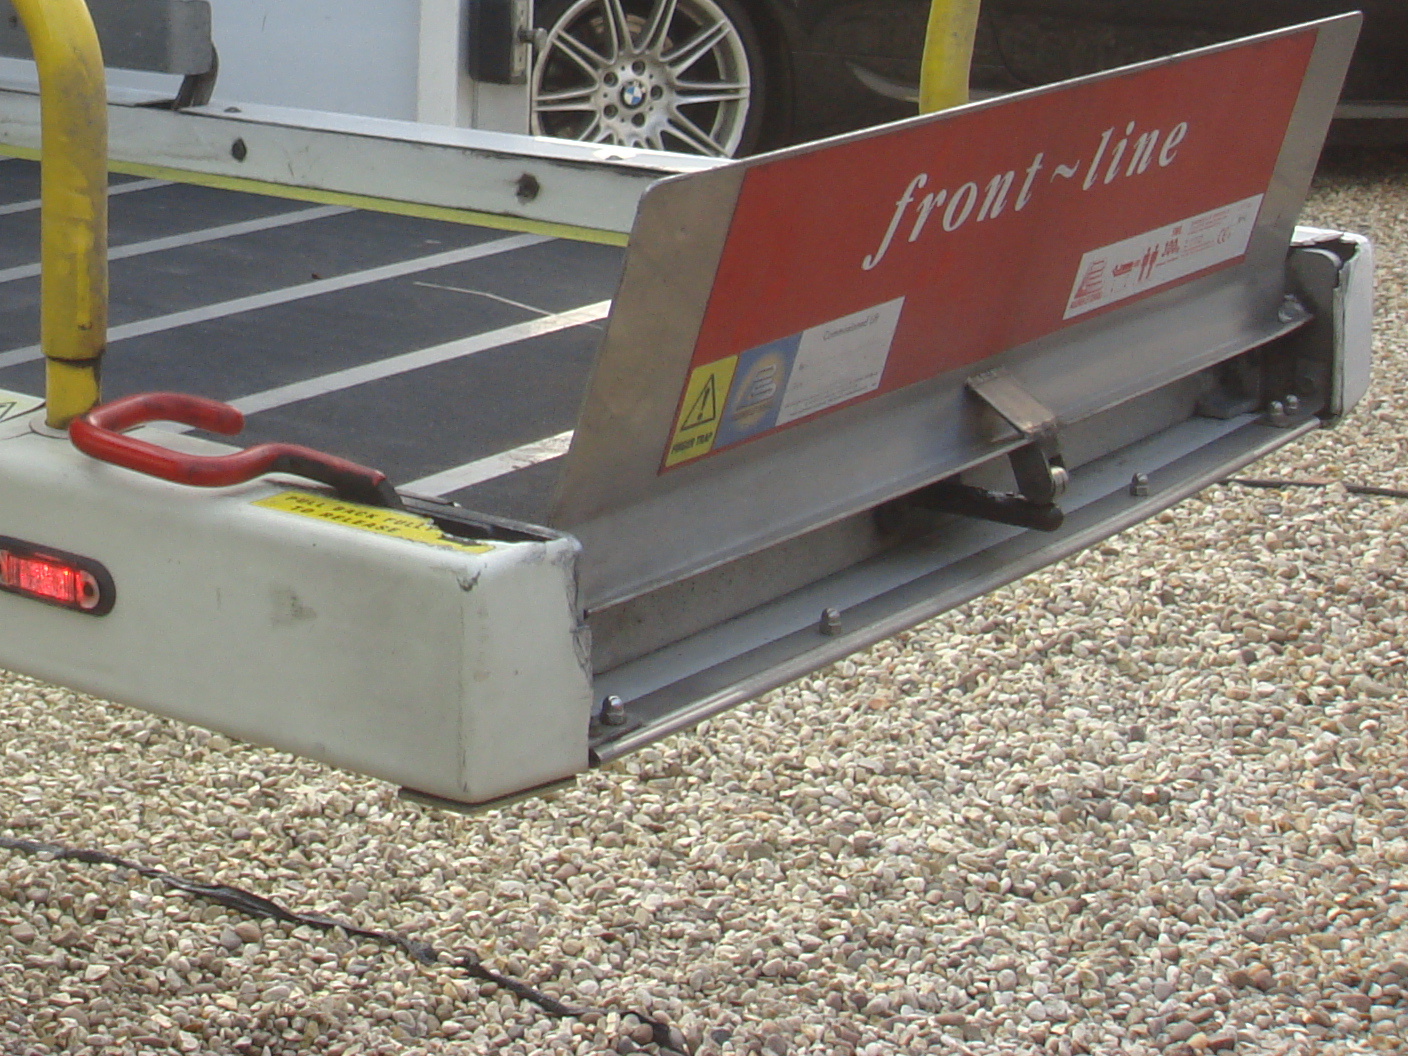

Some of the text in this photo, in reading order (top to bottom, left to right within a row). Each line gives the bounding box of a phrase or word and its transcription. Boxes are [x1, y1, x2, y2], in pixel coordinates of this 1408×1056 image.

[285, 496, 325, 508] PULL
[333, 506, 379, 520] BACK
[290, 505, 401, 533] TO RELEASE
